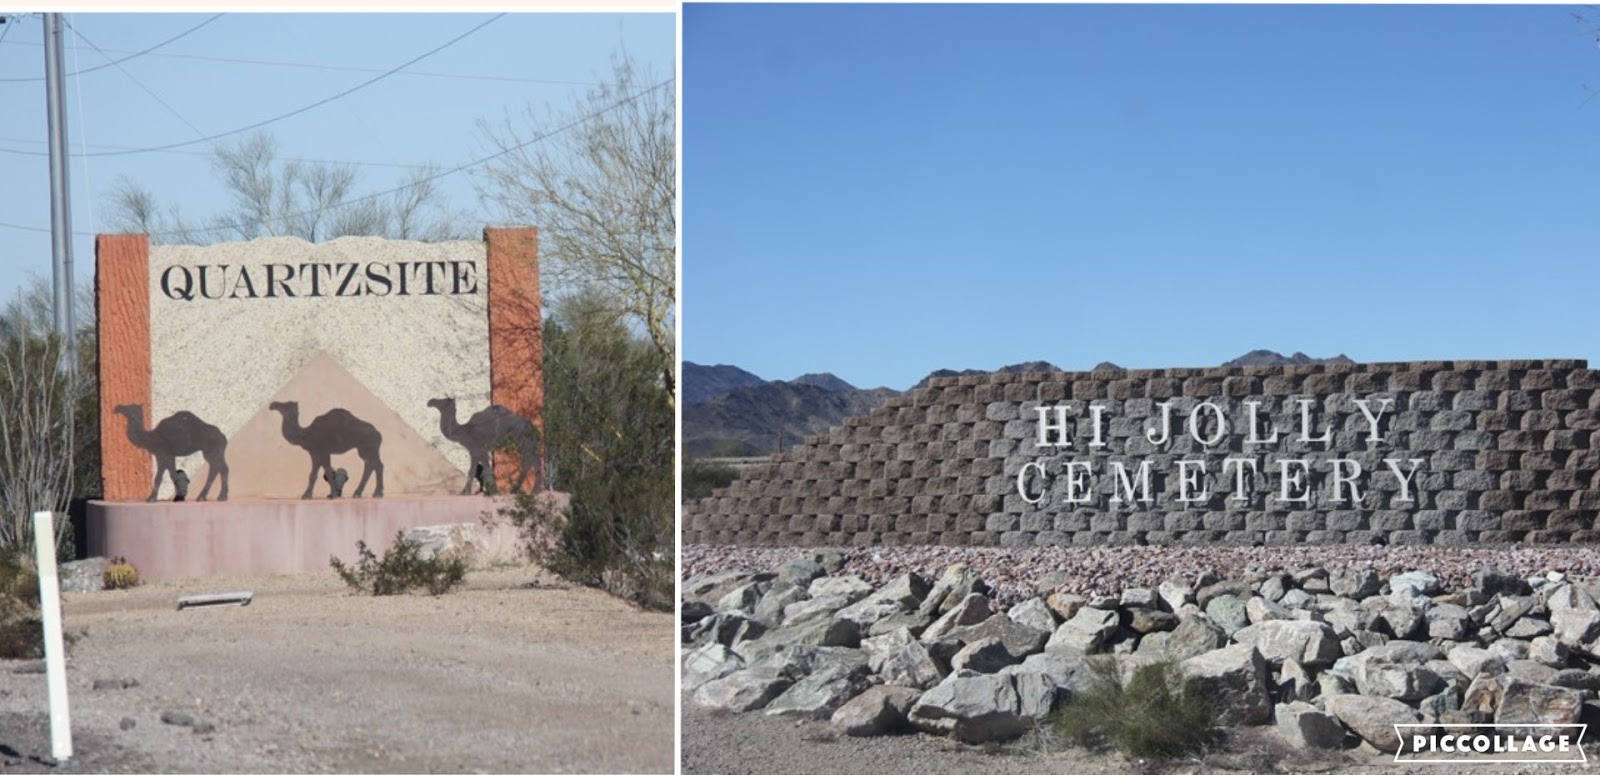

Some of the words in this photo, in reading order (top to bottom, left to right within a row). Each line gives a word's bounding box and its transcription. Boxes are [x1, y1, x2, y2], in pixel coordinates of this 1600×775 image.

[160, 260, 478, 301] QUARTZSITE
[1035, 405, 1106, 447] HI
[1146, 398, 1393, 445] JOLLY
[1017, 458, 1425, 503] CEMETERY
